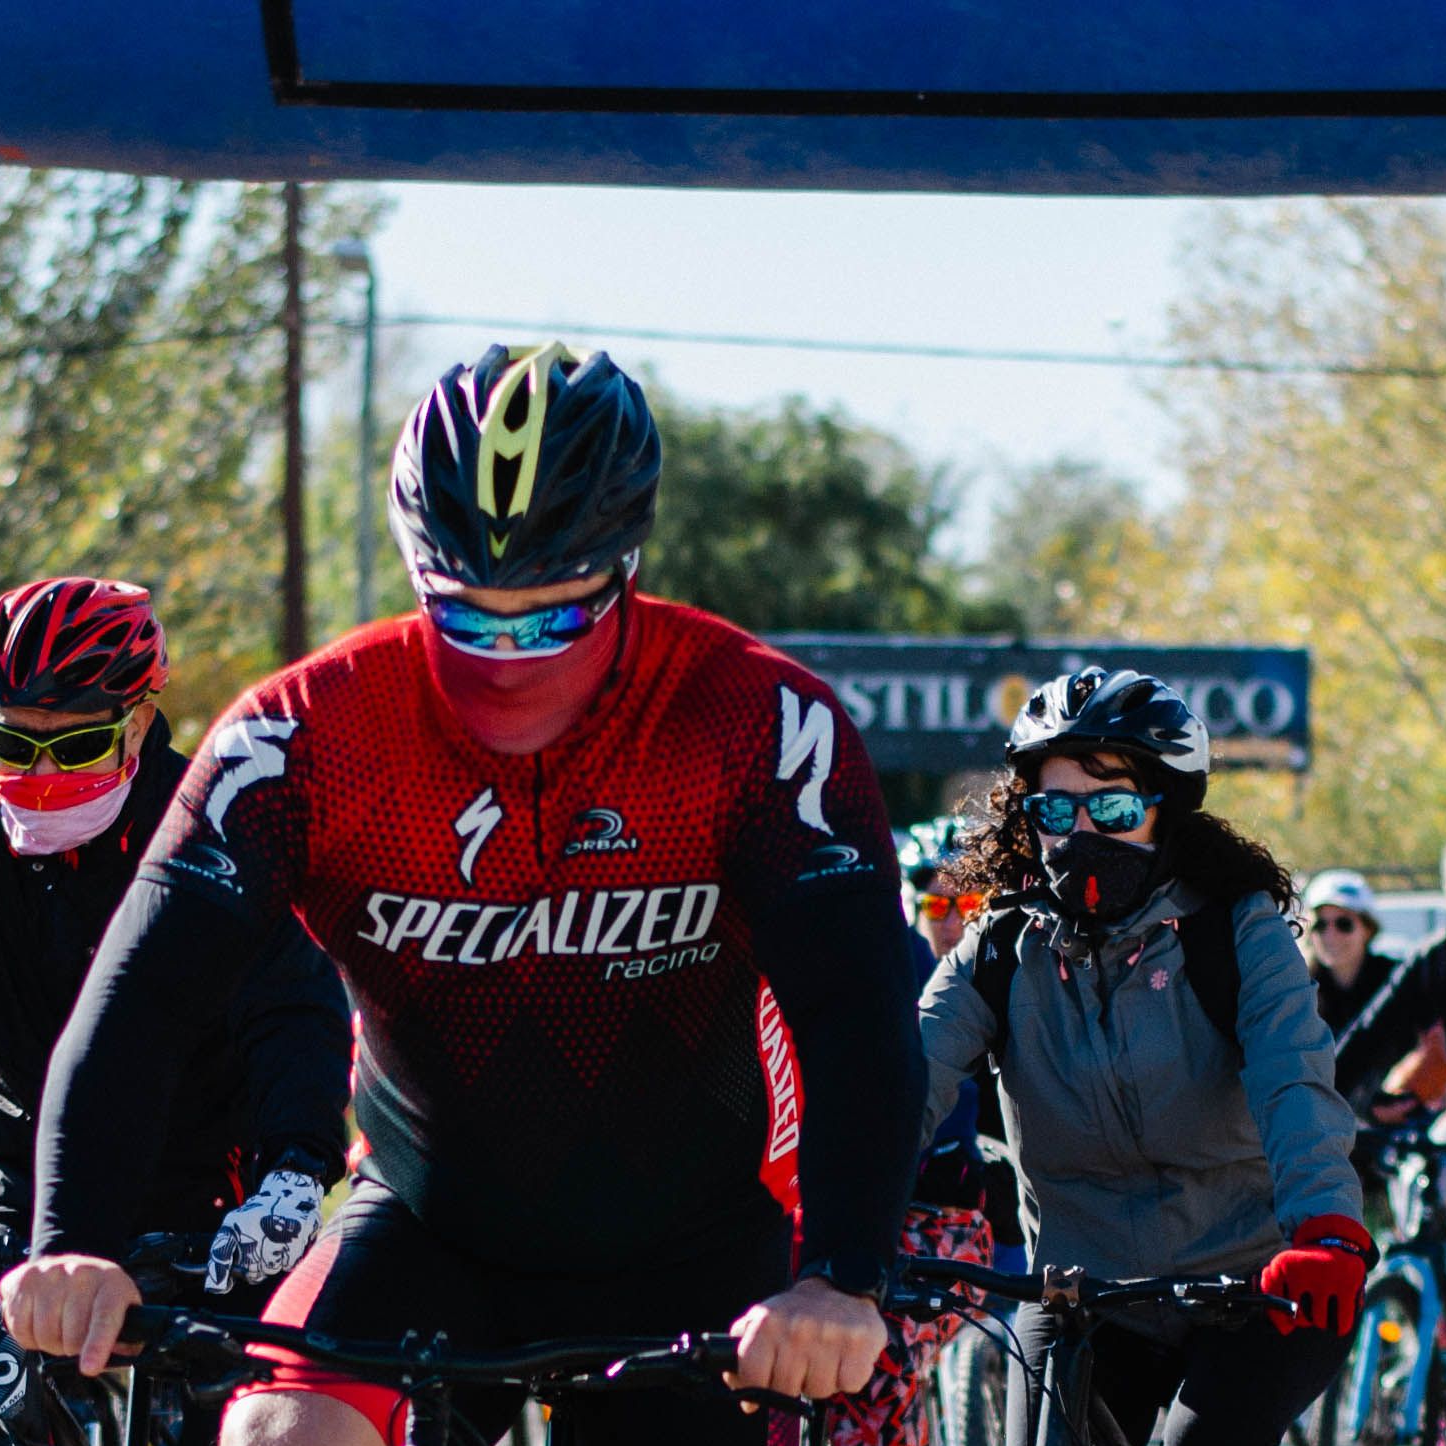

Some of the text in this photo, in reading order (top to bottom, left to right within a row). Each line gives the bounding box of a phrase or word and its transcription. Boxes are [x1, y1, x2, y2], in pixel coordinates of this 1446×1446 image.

[827, 674, 1037, 732] STILO
[1172, 676, 1296, 737] CO
[357, 883, 721, 966] SPECIALIZED
[604, 942, 722, 981] racing
